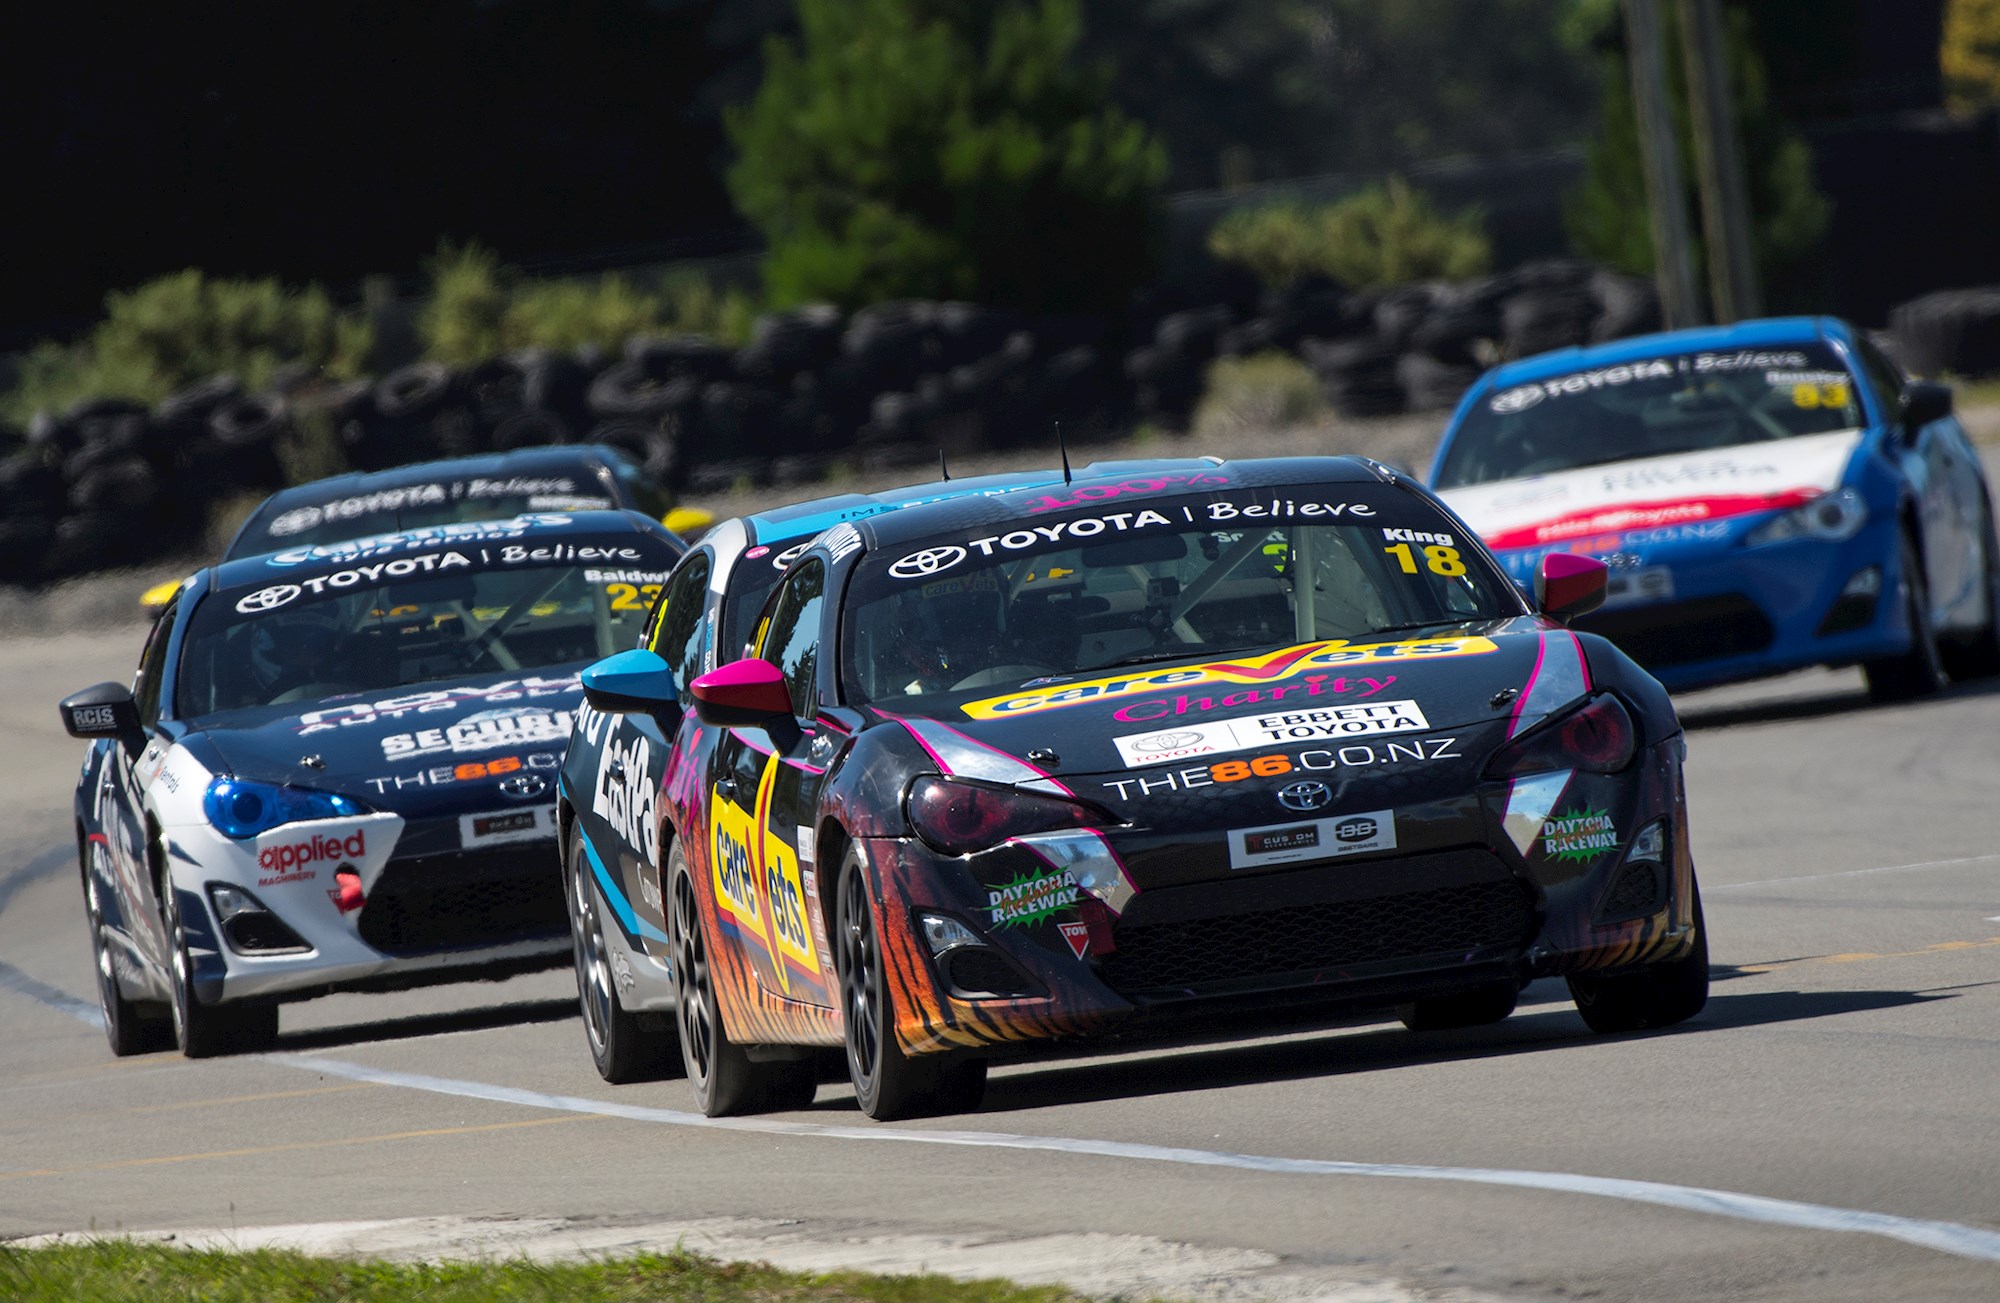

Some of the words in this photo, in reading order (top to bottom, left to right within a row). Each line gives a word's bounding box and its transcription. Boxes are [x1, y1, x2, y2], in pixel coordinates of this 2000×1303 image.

[1546, 359, 1671, 398] TOYOTA
[1695, 350, 1808, 372] Believe
[1024, 473, 1230, 513] 100%
[968, 510, 1171, 556] TOYOTA
[1207, 499, 1377, 521] Believe
[1382, 527, 1455, 546] King
[302, 551, 471, 594] TOYOTA
[500, 543, 642, 563] Believe
[1384, 542, 1467, 577] 18
[1113, 674, 1398, 722] Charity
[1258, 703, 1403, 729] EBBETT
[1262, 717, 1419, 741] TOYOTA
[1103, 737, 1462, 801] THE86.CO.NZ
[1131, 745, 1215, 763] TOYOTA
[1544, 815, 1616, 836] DAYTONA
[1545, 832, 1618, 854] RACEWAY
[258, 829, 366, 874] applied
[258, 871, 317, 887] MACHINERY
[989, 871, 1077, 906] DAYTONA
[991, 888, 1079, 923] RACEWAY
